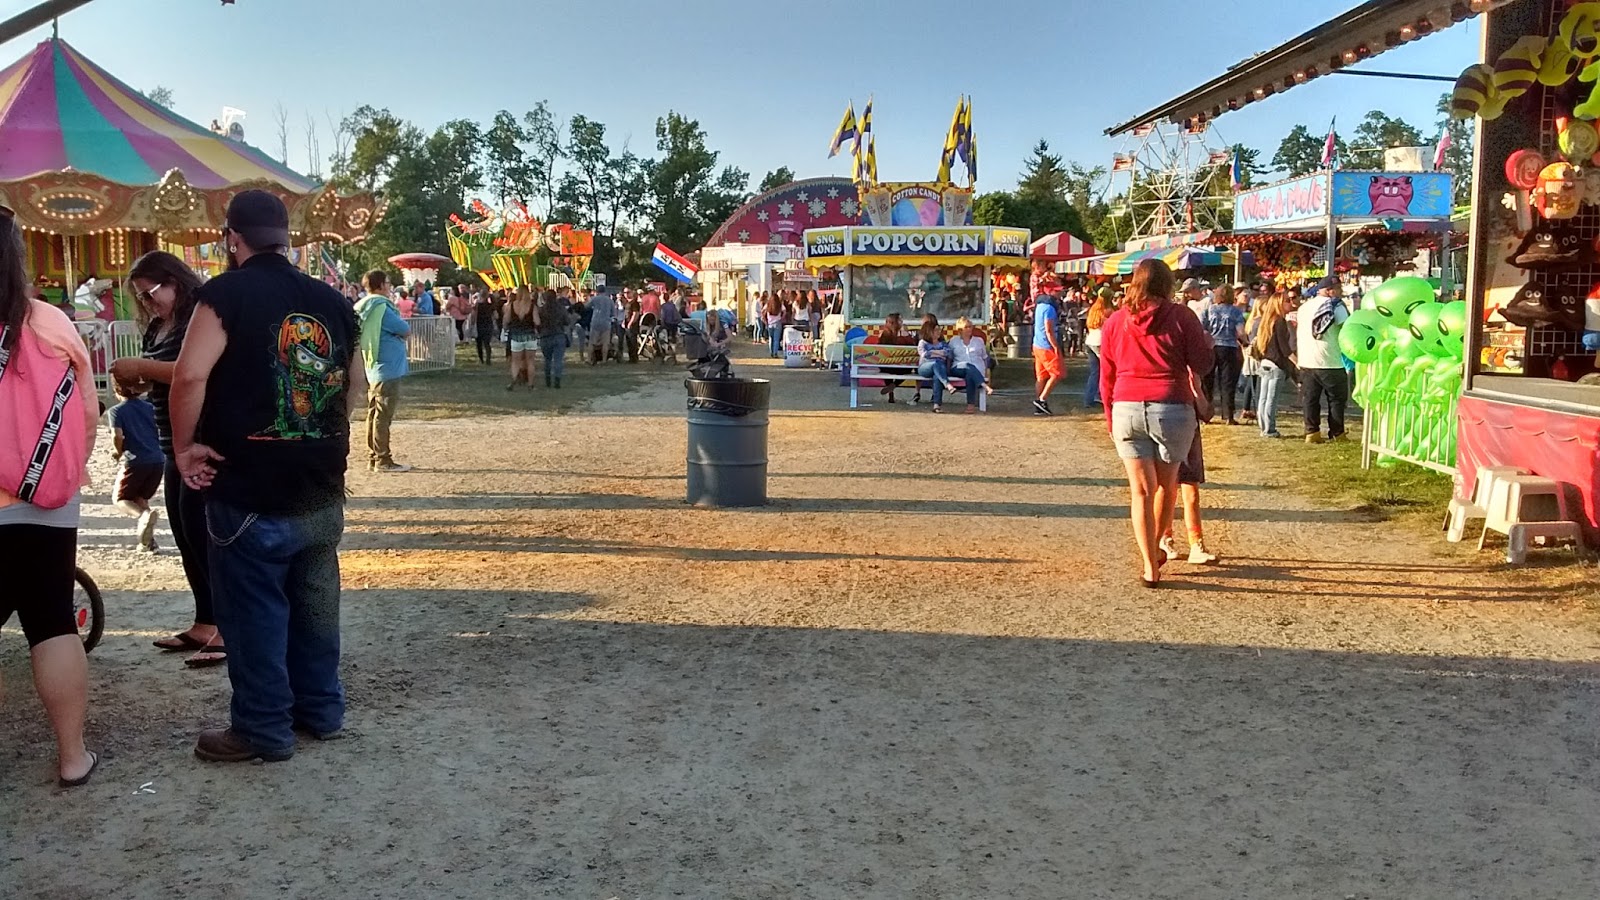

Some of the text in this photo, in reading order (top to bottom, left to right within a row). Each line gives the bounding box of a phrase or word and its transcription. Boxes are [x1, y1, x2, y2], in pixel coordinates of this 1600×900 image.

[892, 187, 941, 203] COTTON CANDY
[816, 234, 835, 245] SNO
[856, 233, 980, 252] POPCORN
[1001, 233, 1019, 243] SNO
[789, 249, 805, 259] TICK
[810, 243, 842, 255] KONES
[995, 242, 1024, 255] KONES
[703, 259, 729, 269] TICKETS
[39, 421, 60, 447] PINK
[24, 461, 44, 487] PINK
